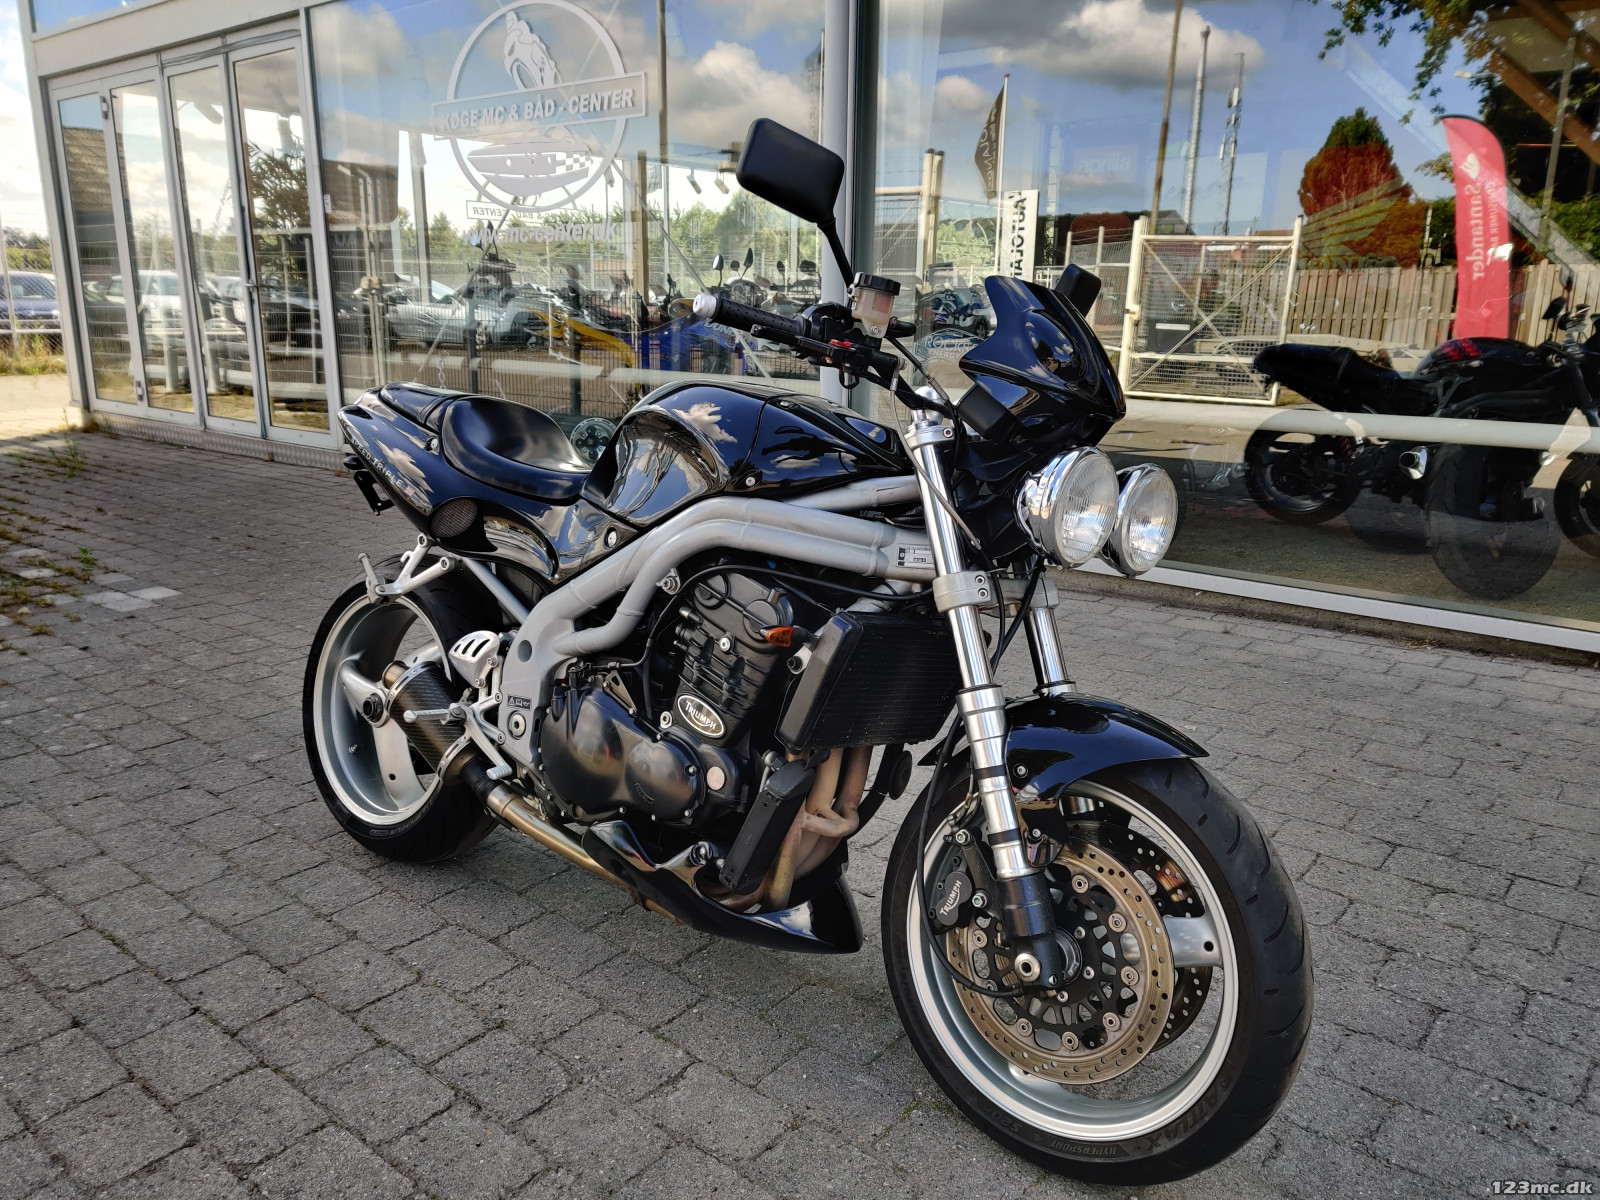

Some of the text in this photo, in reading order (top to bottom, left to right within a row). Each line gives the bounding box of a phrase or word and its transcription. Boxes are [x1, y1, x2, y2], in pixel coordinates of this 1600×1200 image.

[441, 109, 478, 131] KØGE
[482, 108, 505, 126] MC
[509, 103, 520, 121] &
[523, 94, 555, 120] BÅD
[567, 87, 634, 114] CENTER
[371, 457, 404, 489] TRIPLE
[685, 700, 717, 731] TRIUMPH
[940, 879, 962, 916] TRIUMPH
[1049, 1140, 1117, 1156] HYPERSPORT
